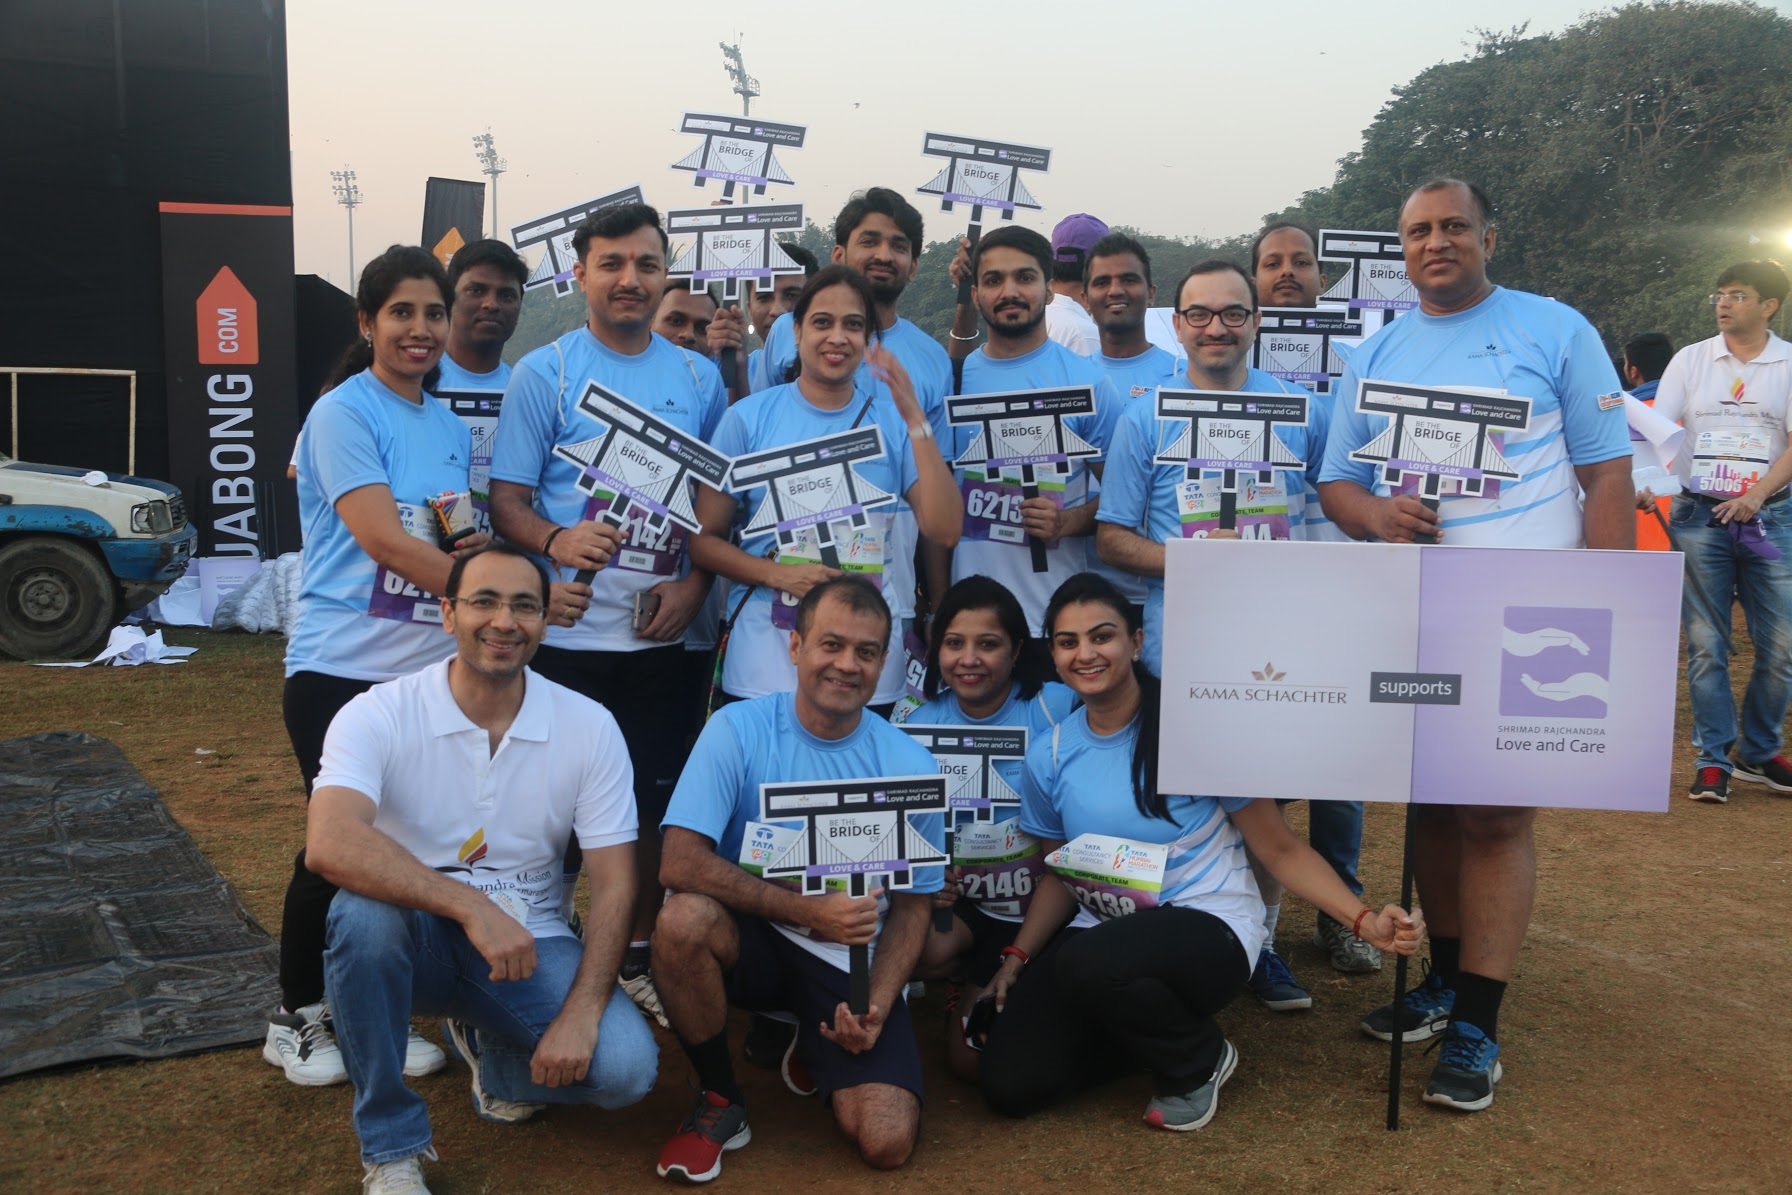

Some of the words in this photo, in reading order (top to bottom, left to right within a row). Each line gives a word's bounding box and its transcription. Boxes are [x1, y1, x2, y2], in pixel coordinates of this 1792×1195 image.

[719, 146, 754, 157] BRIDGE
[964, 169, 1000, 180] BRIDGE
[713, 240, 751, 249] BRIDGE
[1370, 270, 1409, 280] BRIDGE
[217, 308, 239, 353] COM
[1271, 343, 1309, 352] BRIDGE
[1471, 409, 1487, 417] Love
[1489, 411, 1503, 419] and
[1504, 412, 1521, 421] Care
[1001, 426, 1042, 438] BRIDGE
[1209, 429, 1251, 439] BRIDGE
[1414, 428, 1462, 442] BRIDGE
[625, 440, 634, 448] BE
[635, 444, 648, 455] THE
[831, 448, 847, 457] Love
[860, 442, 876, 450] Care
[207, 374, 259, 557] JABONG
[620, 446, 663, 475] BRIDGE
[678, 448, 693, 461] Love
[692, 456, 704, 468] and
[705, 463, 720, 477] Care
[1004, 457, 1022, 465] LOVE
[1408, 462, 1430, 471] LOVE
[1439, 466, 1460, 475] CARE
[604, 477, 624, 490] LOVE
[625, 486, 631, 495] &
[631, 490, 649, 506] CARE
[789, 477, 833, 496] BRIDGE
[967, 489, 1024, 524] 6213
[796, 515, 816, 526] LOVE
[823, 510, 843, 519] CARE
[1378, 679, 1453, 697] supports
[1189, 687, 1239, 700] KAMA
[1245, 689, 1348, 704] SCHACHTER
[1498, 725, 1541, 734] SHRIMAD
[1544, 726, 1606, 736] RAJCHANDRA
[974, 741, 990, 749] Love
[1496, 737, 1532, 750] Love
[1536, 738, 1565, 752] and
[1570, 740, 1606, 753] Care
[939, 765, 968, 775] IDGE
[886, 795, 905, 803] Love
[906, 794, 920, 802] and
[921, 793, 940, 801] Care
[842, 818, 857, 826] THE
[830, 824, 880, 838] BRIDGE
[751, 840, 774, 850] TATA
[830, 864, 852, 873] LOVE
[854, 864, 860, 872] &
[862, 862, 885, 872] CARE
